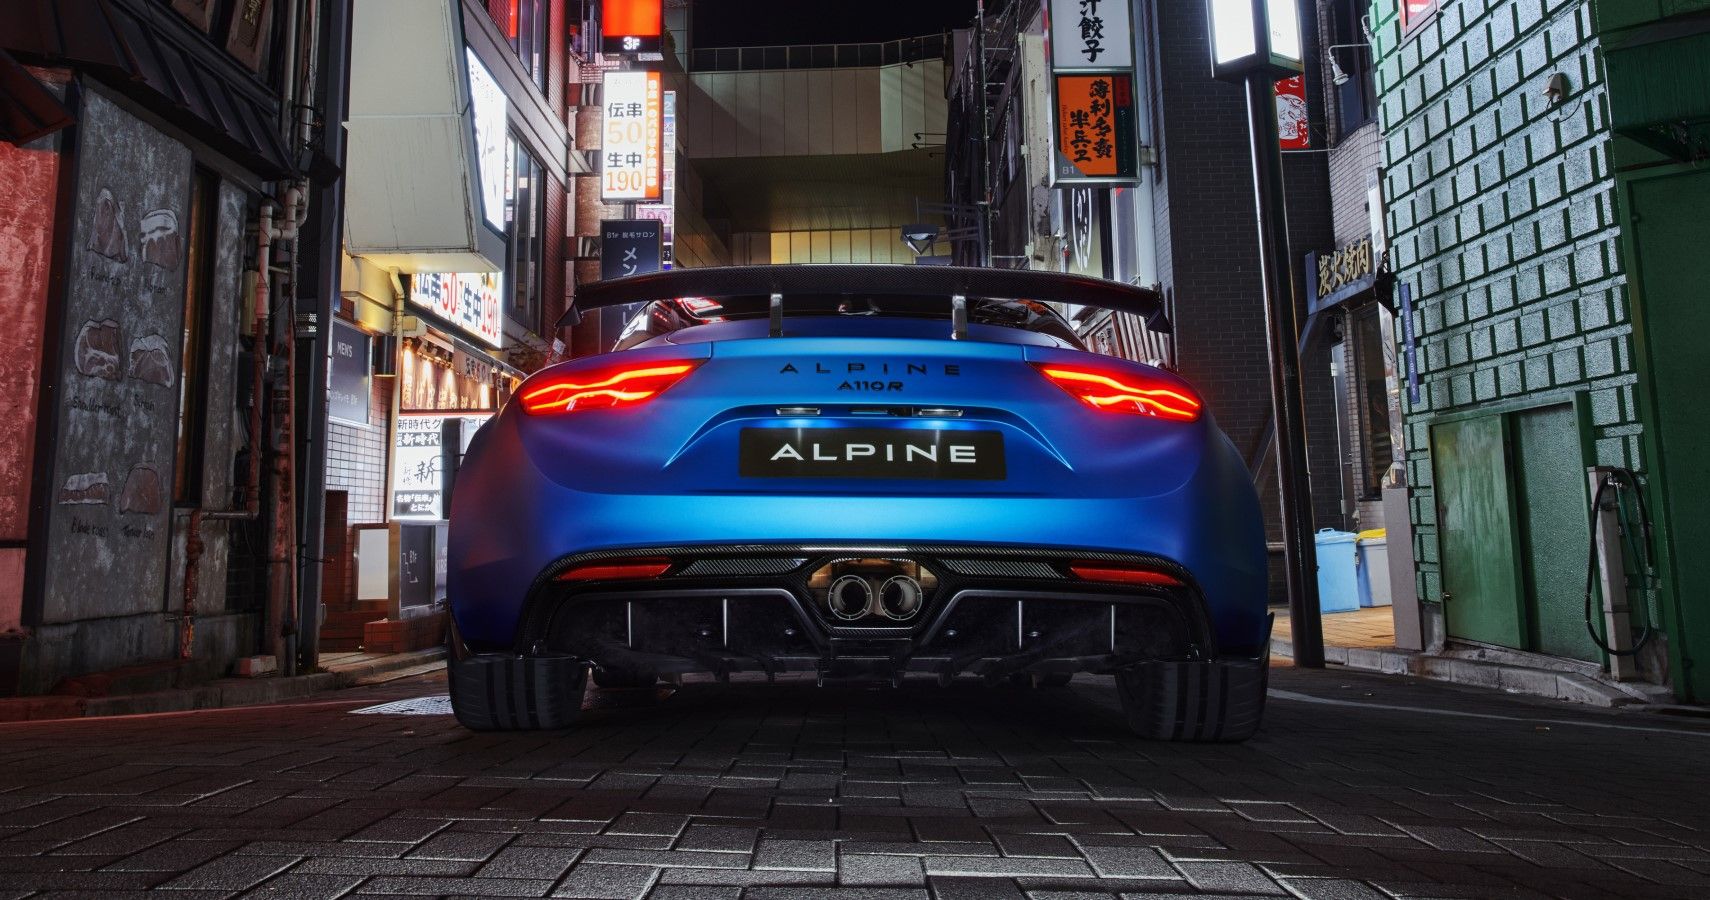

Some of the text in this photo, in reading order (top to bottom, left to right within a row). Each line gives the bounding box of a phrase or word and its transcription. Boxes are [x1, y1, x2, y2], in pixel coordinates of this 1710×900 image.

[623, 36, 640, 50] 3F
[608, 102, 642, 118] 伝串
[607, 121, 642, 145] 50
[607, 152, 642, 168] 生中
[606, 171, 642, 191] 190
[780, 363, 960, 376] ALPINE
[770, 443, 977, 463] ALPINE
